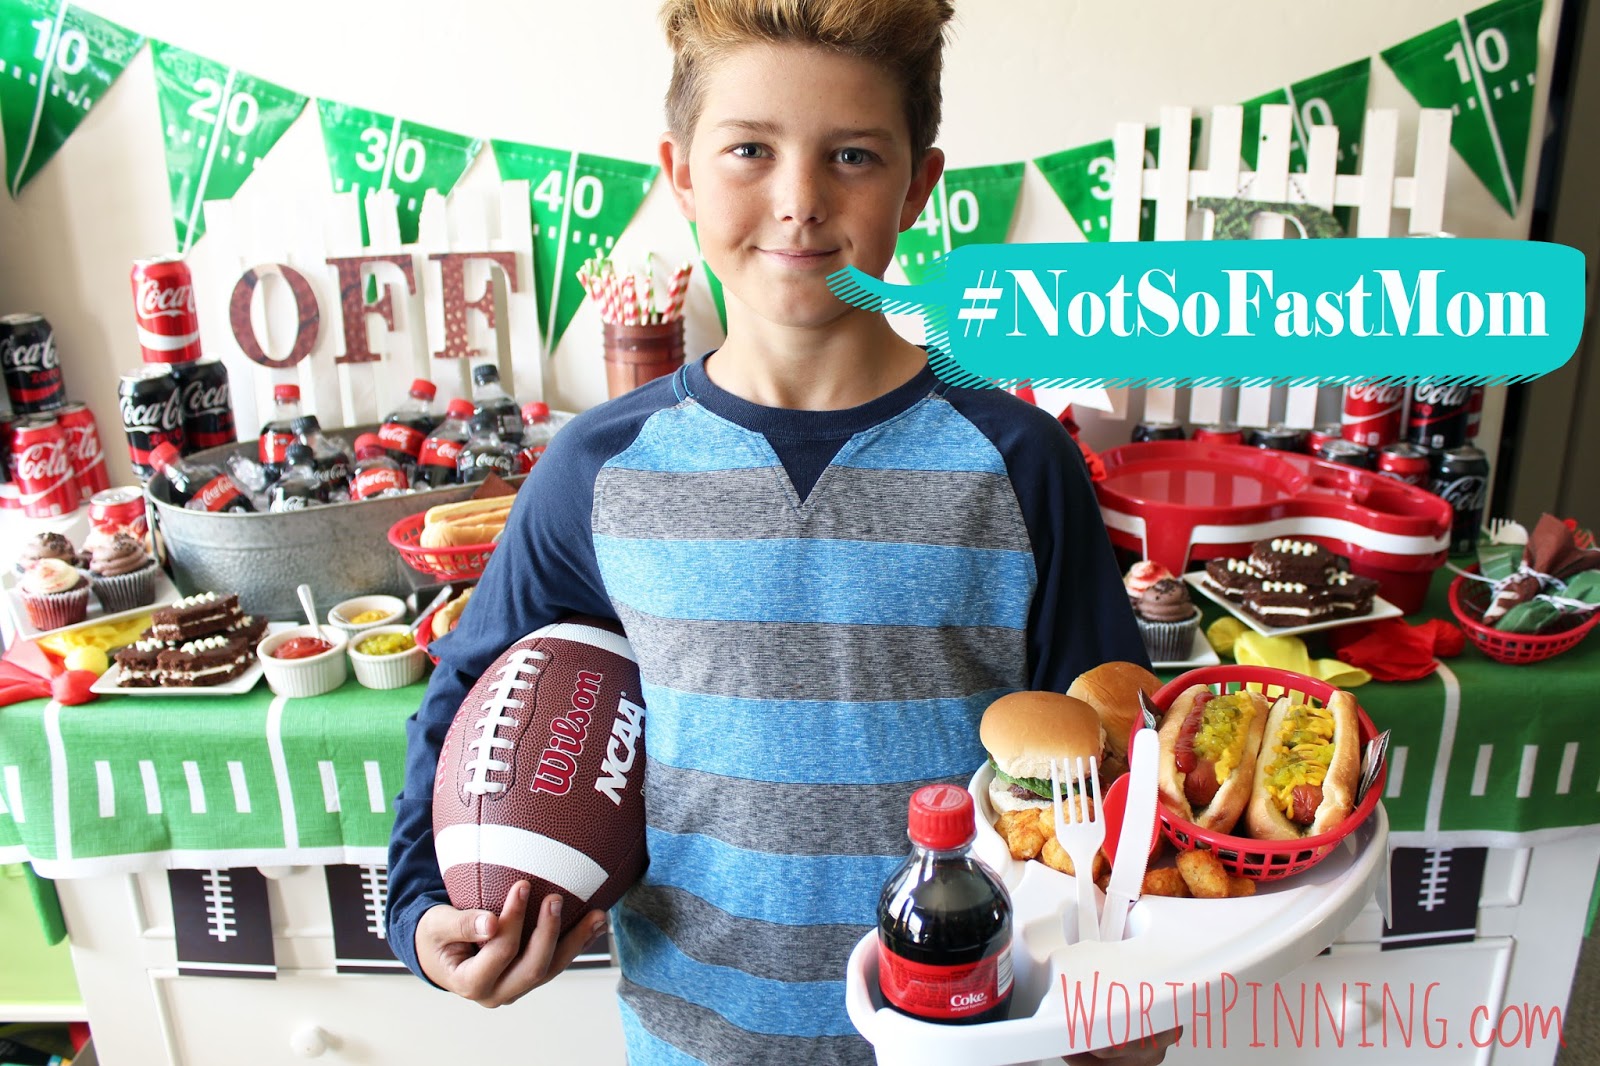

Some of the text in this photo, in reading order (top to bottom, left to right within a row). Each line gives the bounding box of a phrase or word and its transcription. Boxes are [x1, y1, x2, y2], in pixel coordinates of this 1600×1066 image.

[32, 18, 89, 75] 10
[1443, 28, 1510, 84] 10
[187, 78, 259, 136] 20
[355, 127, 426, 183] 30
[533, 170, 604, 219] 40
[911, 189, 979, 236] 40
[229, 251, 519, 369] OFF
[18, 440, 67, 480] Cola
[530, 670, 602, 796] Wilson
[594, 698, 646, 807] NCAA
[950, 992, 984, 1007] Coke
